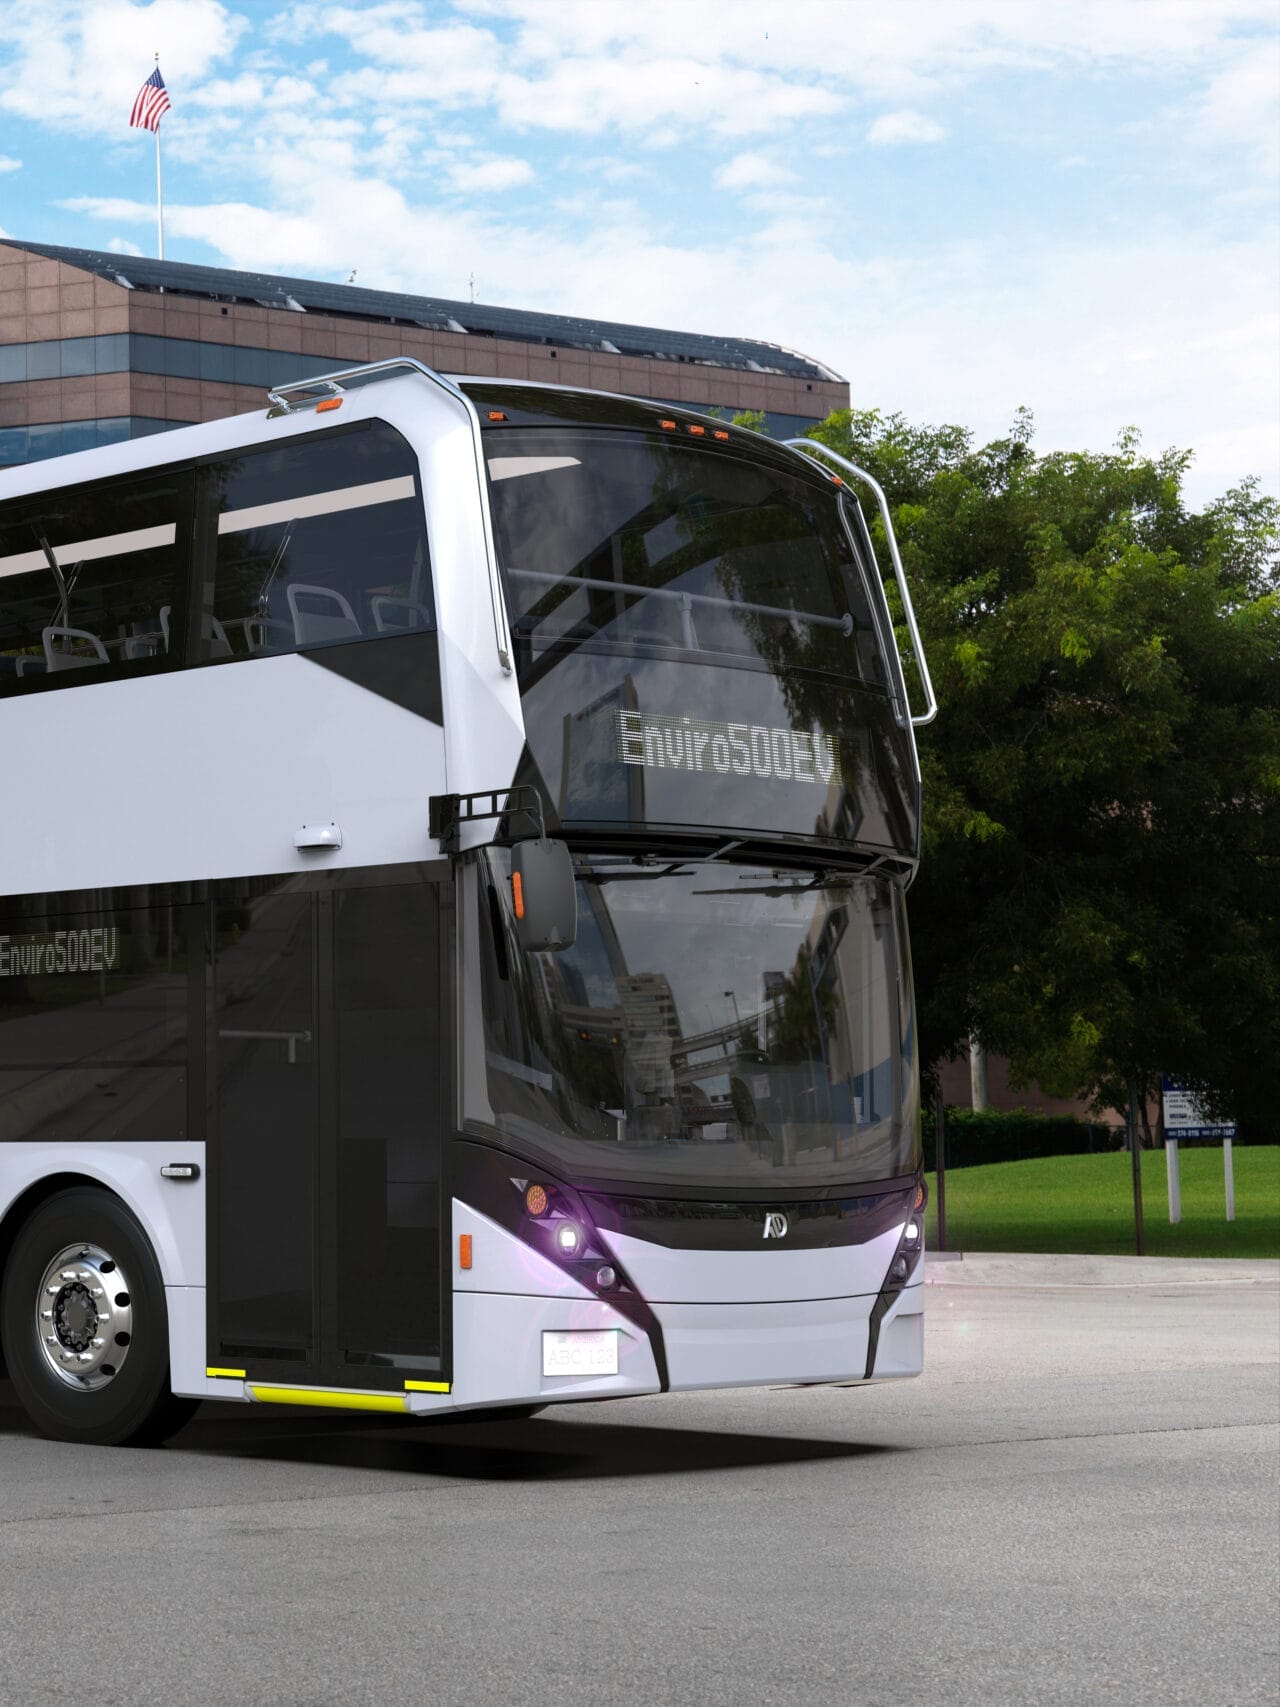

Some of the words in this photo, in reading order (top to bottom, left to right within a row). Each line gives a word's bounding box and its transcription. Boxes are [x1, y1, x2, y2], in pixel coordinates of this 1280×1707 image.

[619, 709, 835, 785] Enviro500EV
[547, 1349, 582, 1366] ABC
[587, 1348, 615, 1365] 123
